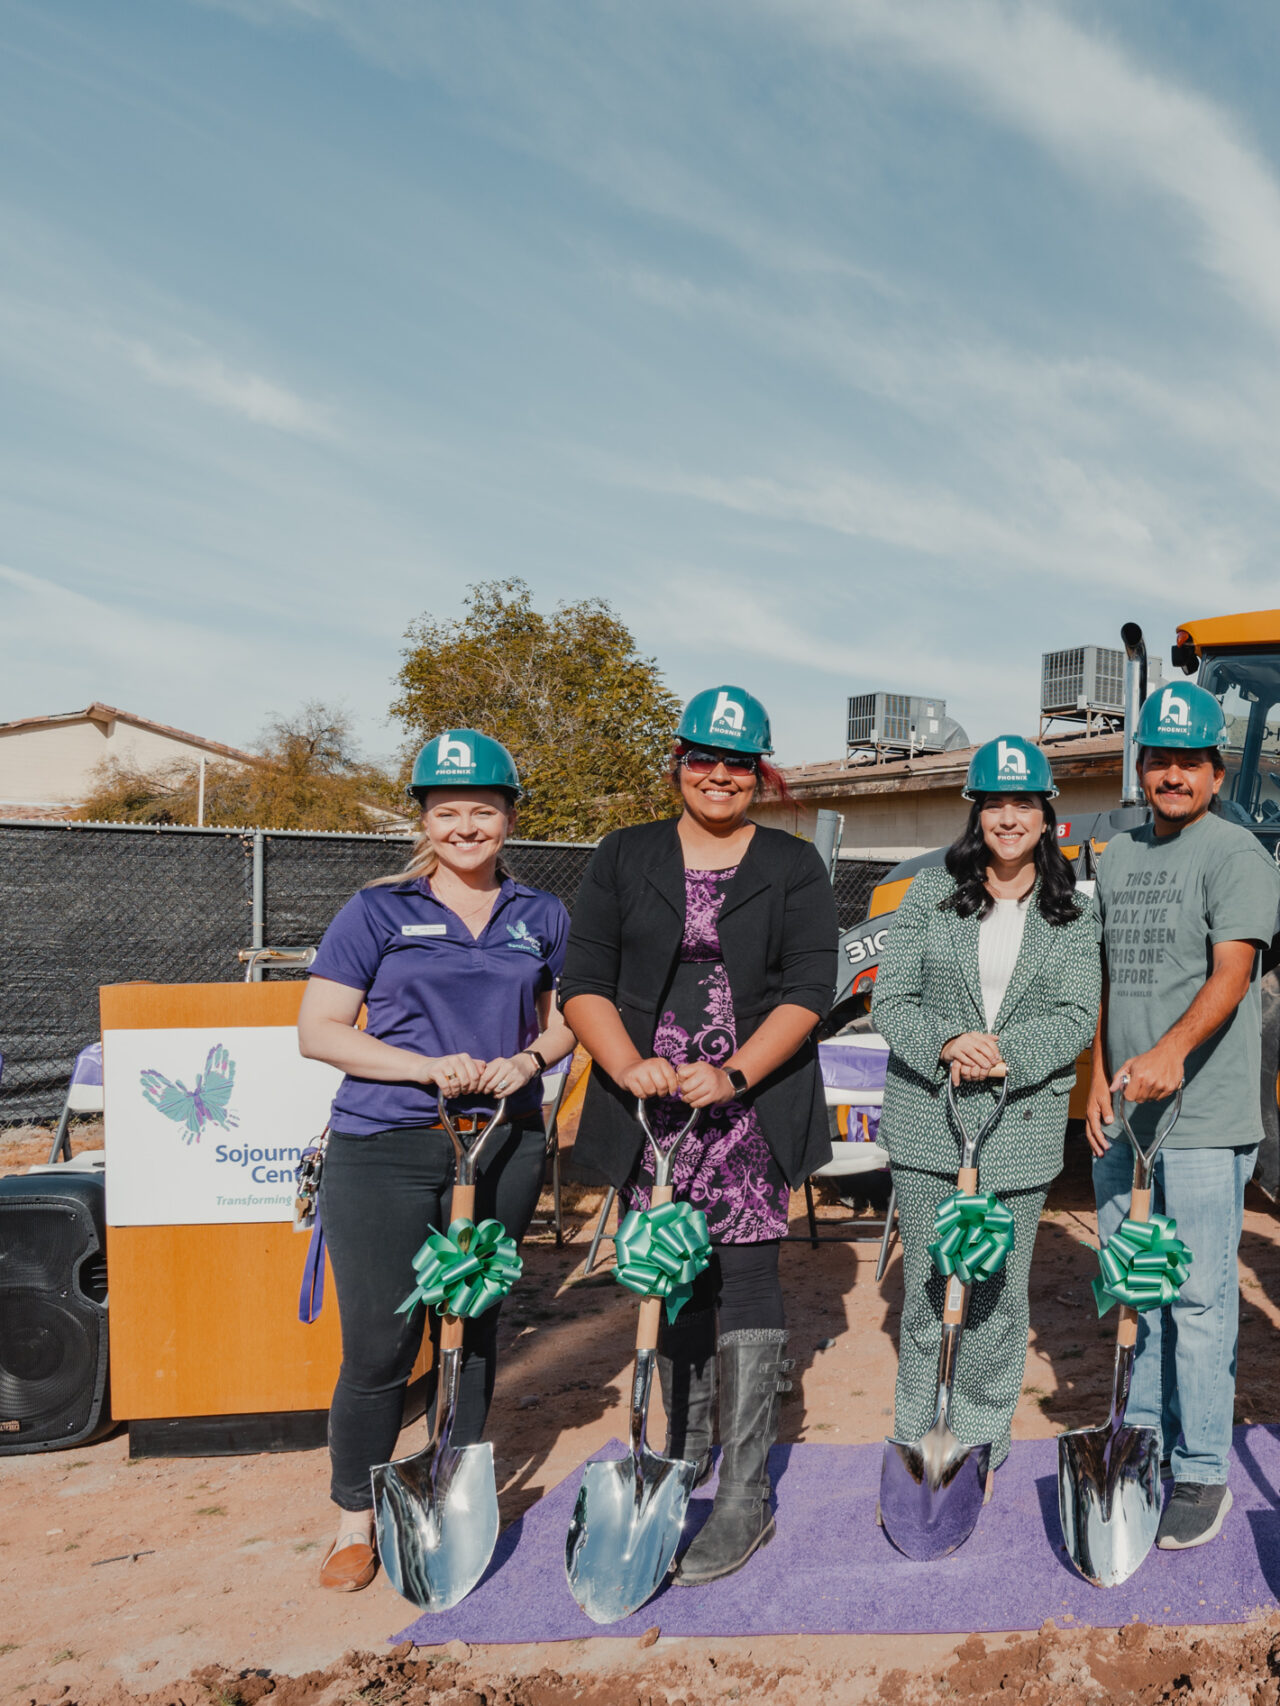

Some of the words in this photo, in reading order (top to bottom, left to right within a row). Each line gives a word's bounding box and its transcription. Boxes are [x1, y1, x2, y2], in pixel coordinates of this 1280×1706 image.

[709, 727, 742, 737] PHOENIX
[1158, 726, 1188, 734] PHOENIX
[1126, 871, 1152, 887] THIS
[1153, 871, 1168, 886] IS
[1170, 870, 1178, 885] A
[1111, 889, 1183, 906] WONDERFUL
[1112, 908, 1140, 924] DAY.
[1143, 908, 1168, 924] I'VE
[1103, 929, 1140, 944] NEVER
[1143, 928, 1177, 944] SEEN
[1110, 948, 1136, 964] THIS
[1138, 948, 1165, 964] ONE
[1109, 968, 1159, 984] BEFORE.
[215, 1143, 302, 1168] Sojourn
[251, 1165, 301, 1184] Cent
[216, 1194, 293, 1208] Transforming
